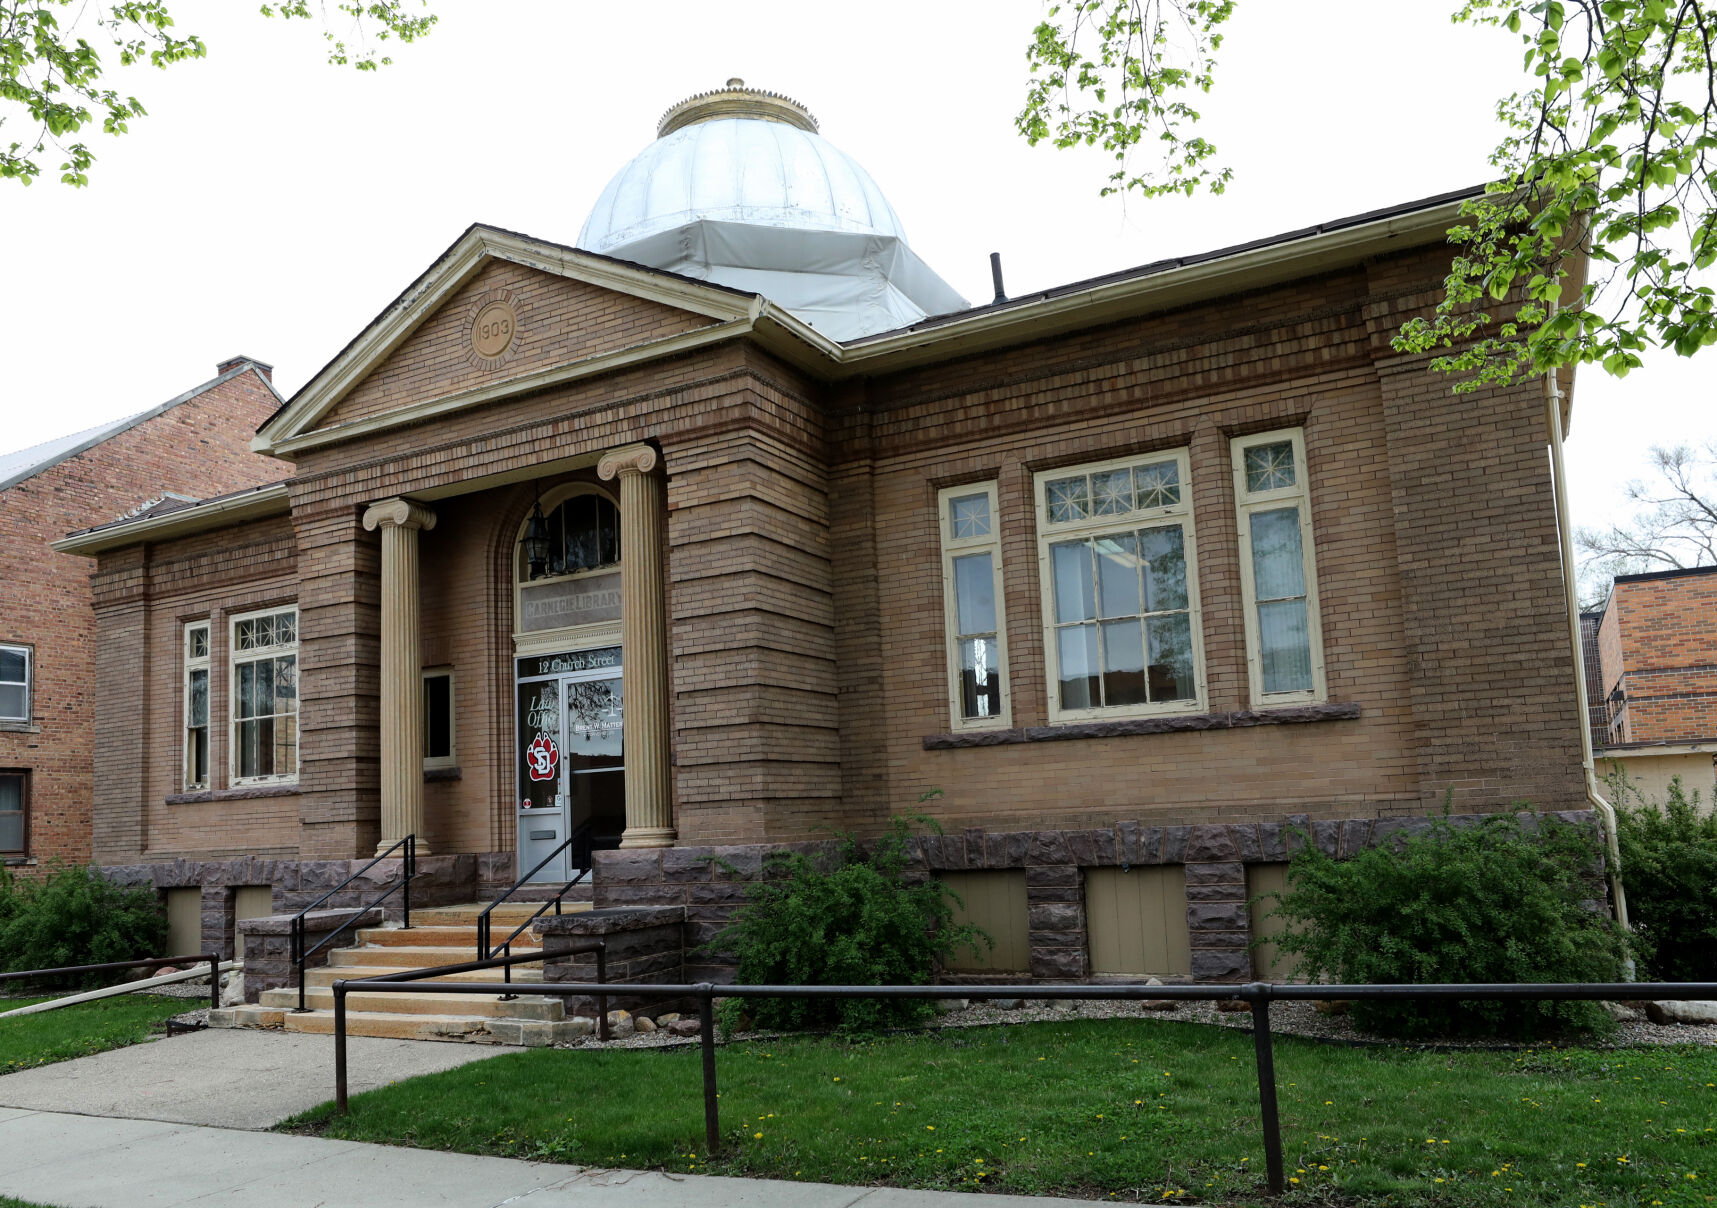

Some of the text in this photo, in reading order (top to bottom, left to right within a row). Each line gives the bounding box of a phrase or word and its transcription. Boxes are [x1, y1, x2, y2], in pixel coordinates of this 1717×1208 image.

[478, 319, 510, 342] 1903
[527, 592, 622, 617] CARNEGIE LIBRARY
[538, 654, 615, 673] 12 Church Street
[529, 696, 555, 710] Law
